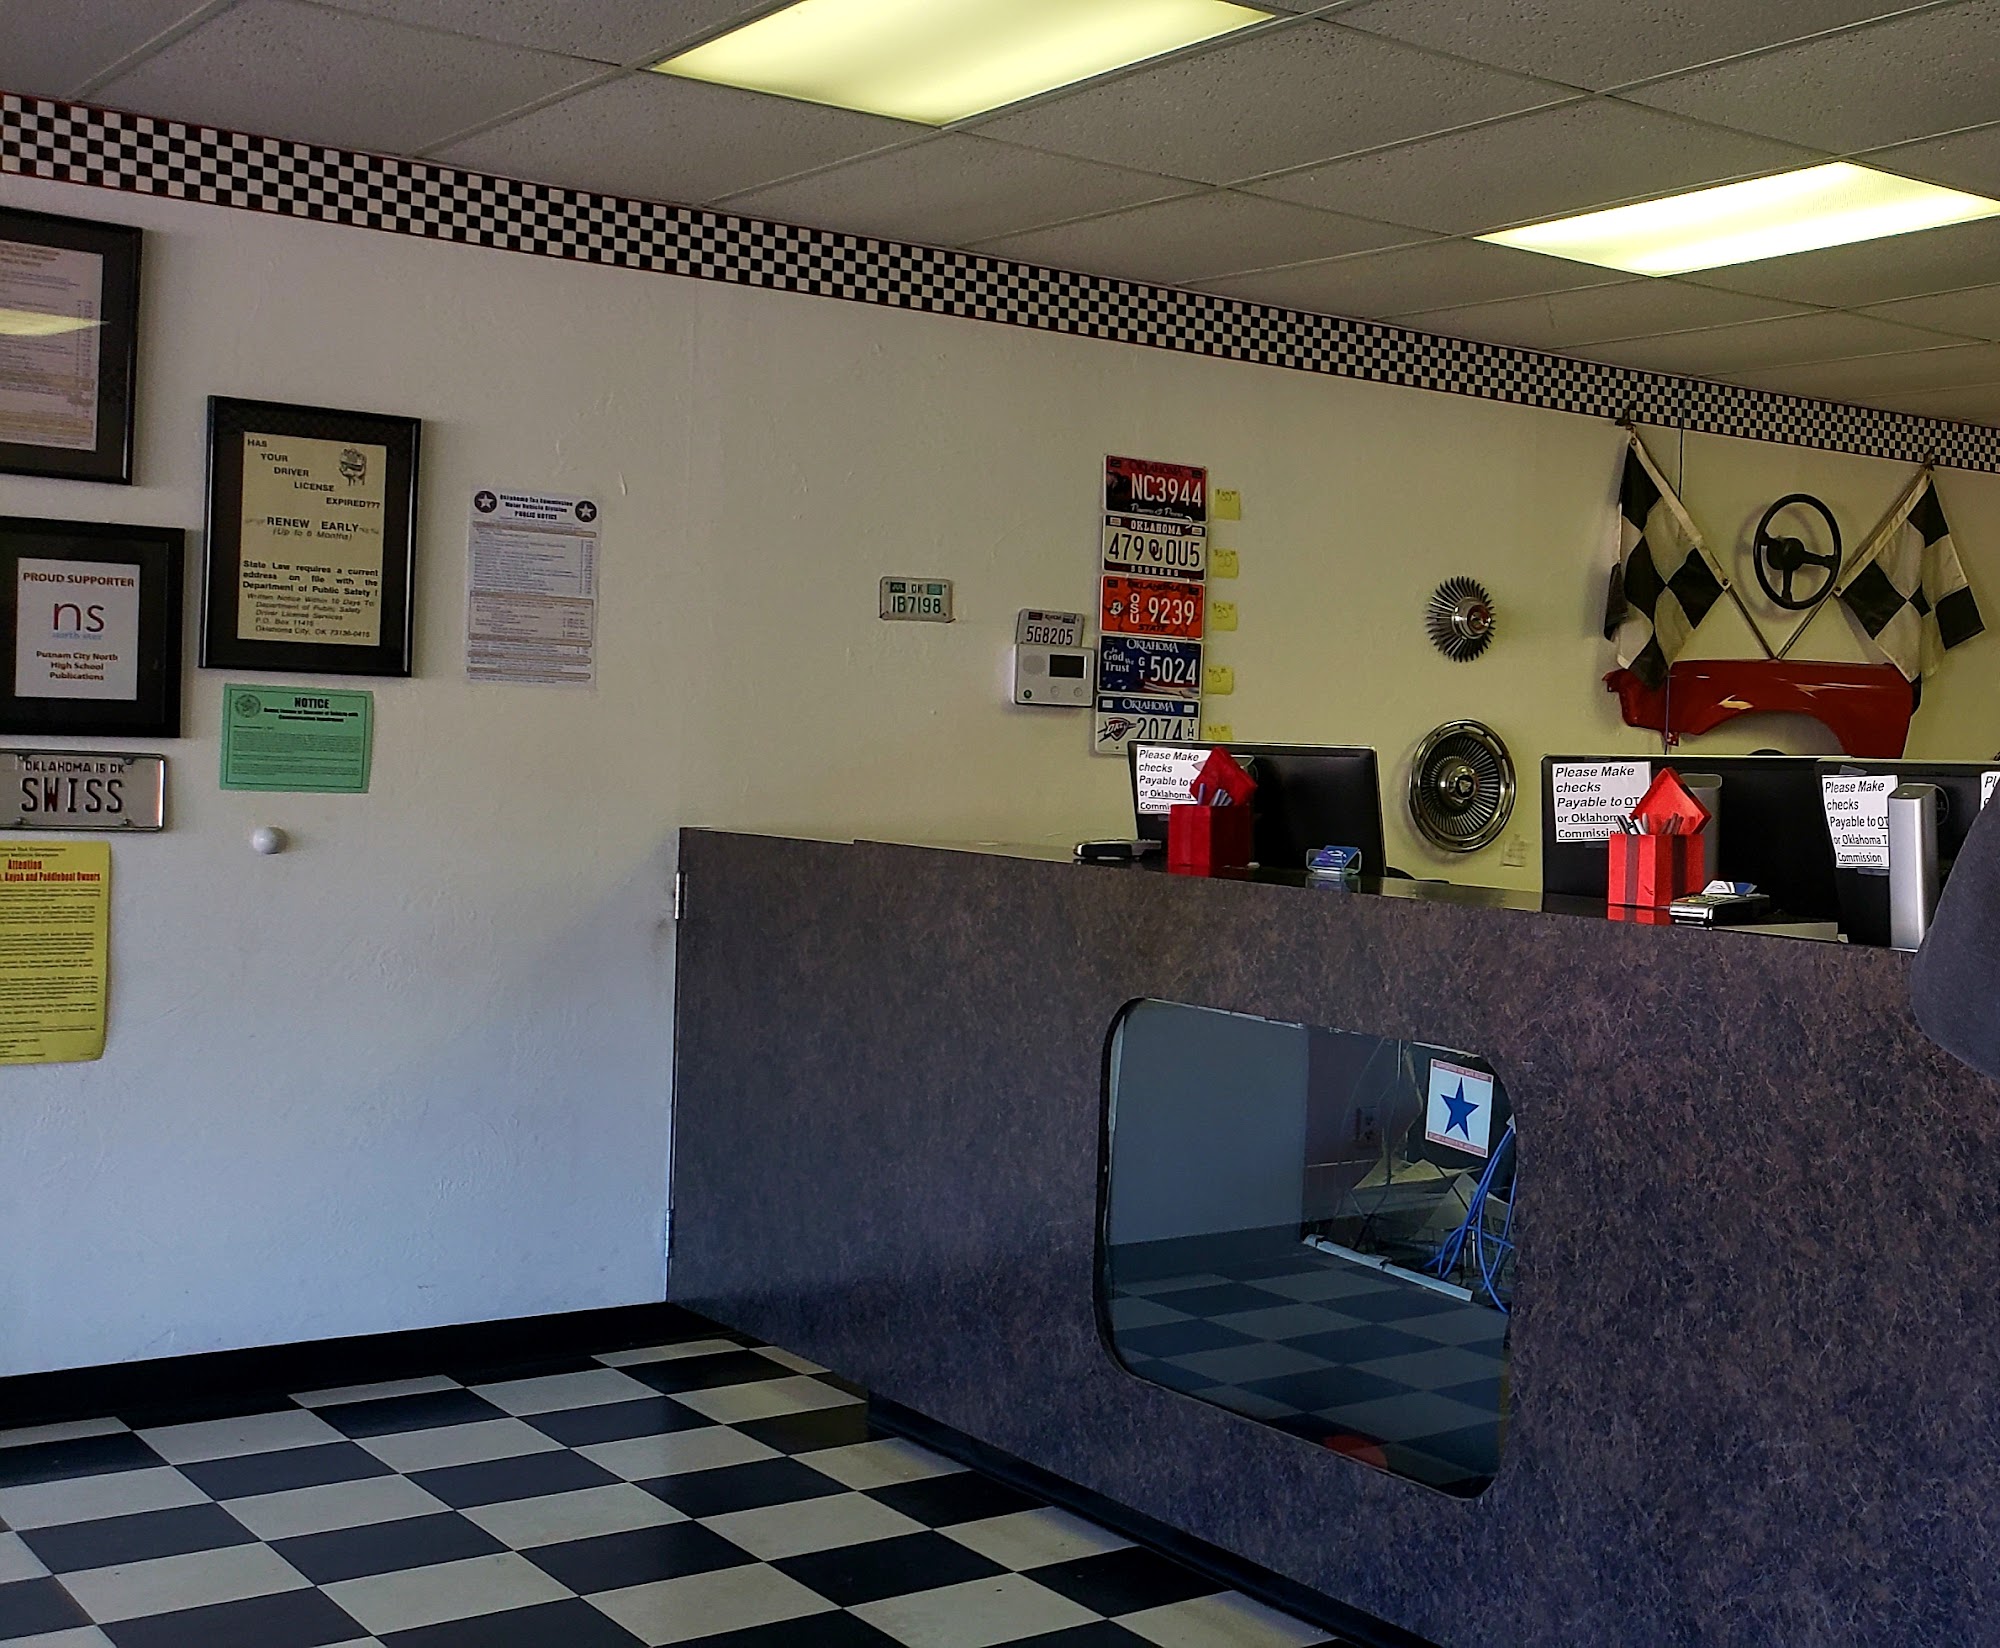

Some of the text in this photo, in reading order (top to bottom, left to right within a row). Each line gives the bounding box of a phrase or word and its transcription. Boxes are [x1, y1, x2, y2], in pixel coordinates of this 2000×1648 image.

[248, 439, 267, 448] HAS
[261, 452, 288, 462] YOUR
[274, 466, 309, 477] DRIVER
[294, 482, 334, 492] LICENSE
[1131, 473, 1202, 508] NC3944
[326, 497, 380, 509] EXPIRED???
[267, 516, 310, 528] RENEW
[320, 521, 358, 532] EARLY
[1130, 520, 1182, 536] OKLAHOMA
[1108, 532, 1144, 561] 479
[243, 560, 266, 570] State
[272, 562, 290, 570] Law
[296, 564, 331, 574] requires
[348, 567, 378, 576] current
[1130, 564, 1179, 577] SOONERS
[23, 572, 134, 588] PROUD SUPPORTER
[243, 571, 277, 580] address
[312, 573, 324, 582] file
[336, 576, 354, 586] with
[365, 577, 378, 587] the
[242, 580, 293, 593] Department
[298, 582, 308, 592] of
[312, 584, 339, 594] Public
[344, 588, 370, 598] Safety
[912, 584, 924, 594] OK
[53, 602, 105, 633] ns
[1148, 596, 1195, 626] 9239
[1026, 626, 1074, 646] 5G8205
[1126, 638, 1179, 654] OKLAHOMA
[74, 652, 90, 662] City
[92, 652, 118, 662] North
[1104, 650, 1124, 662] God
[50, 662, 104, 672] High School
[1104, 662, 1130, 672] Trust
[1150, 656, 1196, 686] 5024
[50, 672, 104, 682] Publications
[294, 697, 330, 709] NOTICE
[1122, 698, 1175, 713] OKLAHOMA
[1139, 750, 1199, 762] Please Make
[25, 760, 91, 772] OKLAHOMA
[110, 763, 124, 774] OK
[1139, 762, 1173, 774] checks
[1556, 766, 1635, 778] Please Make
[1139, 775, 1177, 788] Payable
[1179, 778, 1188, 787] to
[1556, 782, 1602, 793] checks
[1825, 780, 1885, 794] Please Make
[21, 777, 123, 813] SWISS
[1150, 790, 1192, 800] Oklahoma
[1557, 797, 1607, 810] Payable
[1610, 796, 1622, 806] to
[1826, 798, 1859, 811] checks
[1557, 812, 1619, 824] or Oklahom
[1830, 816, 1865, 830] Payable
[1867, 816, 1876, 827] to
[1834, 836, 1840, 844] or
[1842, 834, 1882, 846] Oklahoma
[1838, 852, 1882, 864] Commission
